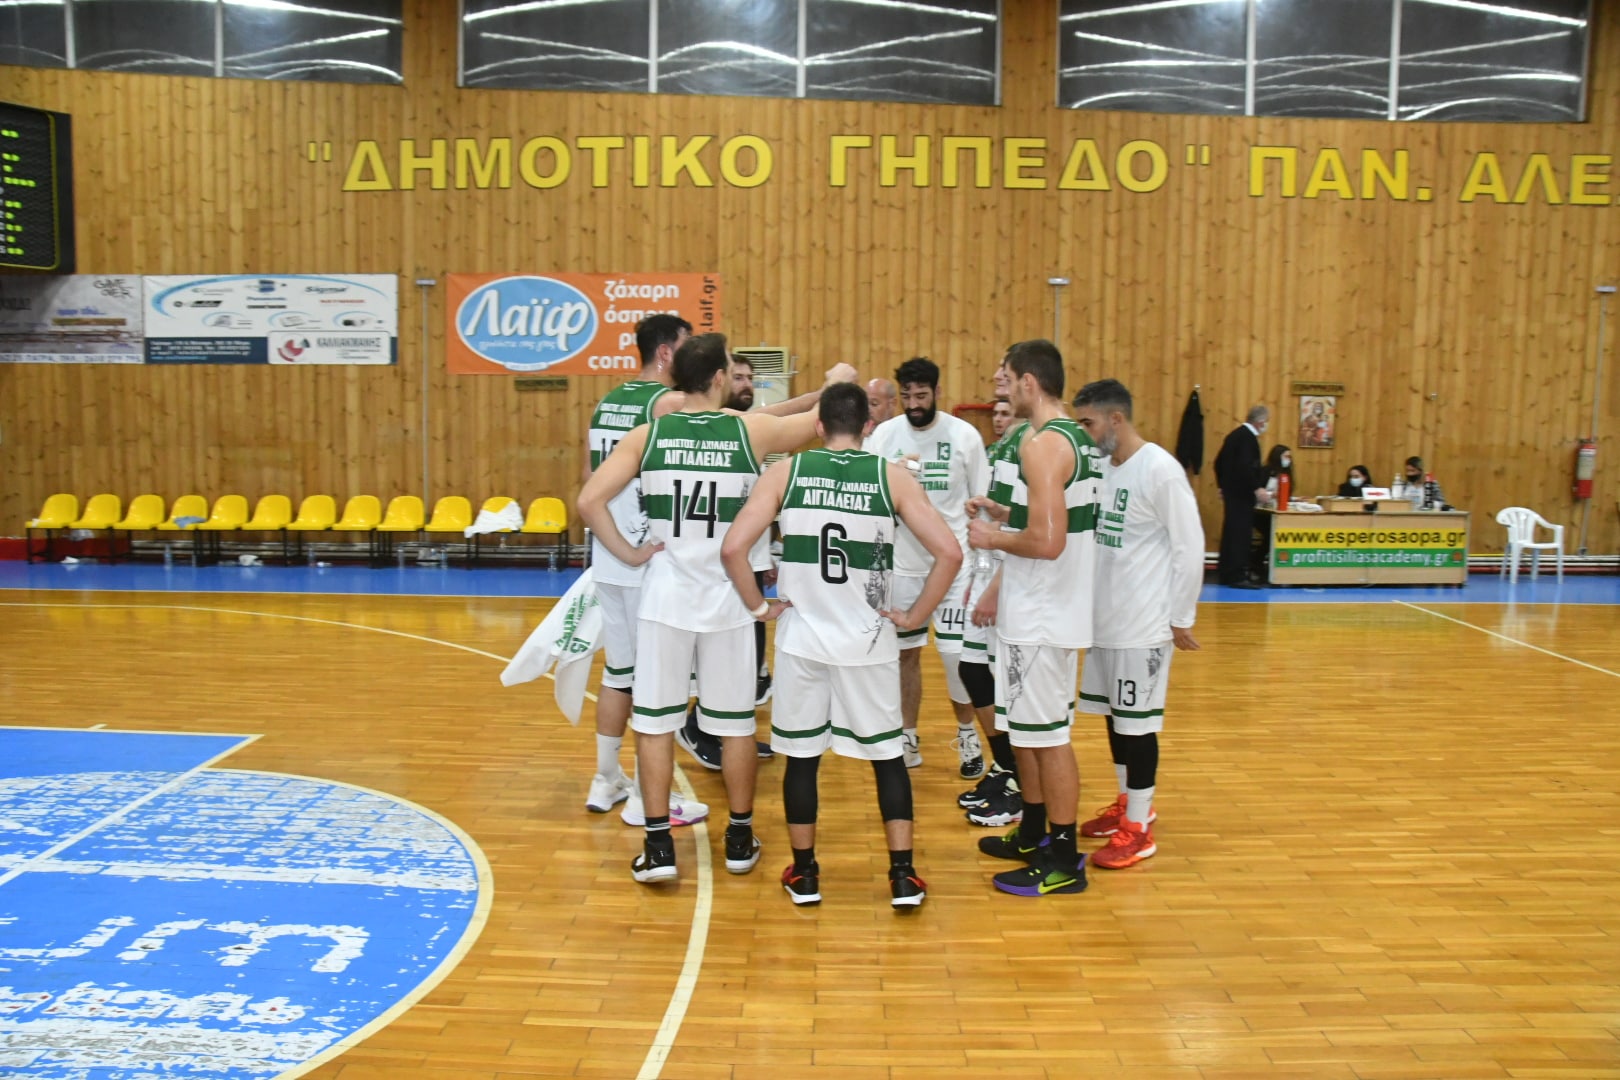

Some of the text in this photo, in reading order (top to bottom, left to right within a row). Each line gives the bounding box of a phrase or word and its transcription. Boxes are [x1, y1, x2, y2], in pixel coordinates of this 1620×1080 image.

[307, 135, 1620, 206] "ΔΗΜΟΤΙΚΟ ΓΗΠΕΔΟ" ΠΑΝ. ΑΛΕ
[603, 279, 680, 303] ζάχαρη
[604, 304, 680, 323] όσπ
[699, 276, 718, 332] .laif.gr
[464, 289, 590, 351] Λαϊφ
[588, 355, 637, 370] corn
[664, 449, 732, 467] ΑΙΓΙΑΛΕΙΑΣ
[937, 441, 951, 461] 13
[673, 479, 718, 538] 14
[802, 489, 873, 512] ΑΙΓΙΑΛΕΙΑΣ
[1113, 487, 1129, 512] 19
[1275, 531, 1466, 547] www.esperosaopa.gr
[820, 522, 849, 585] 6
[1292, 550, 1449, 566] profitisiliasacademy.gr
[941, 607, 966, 631] 44
[1117, 679, 1136, 706] 13
